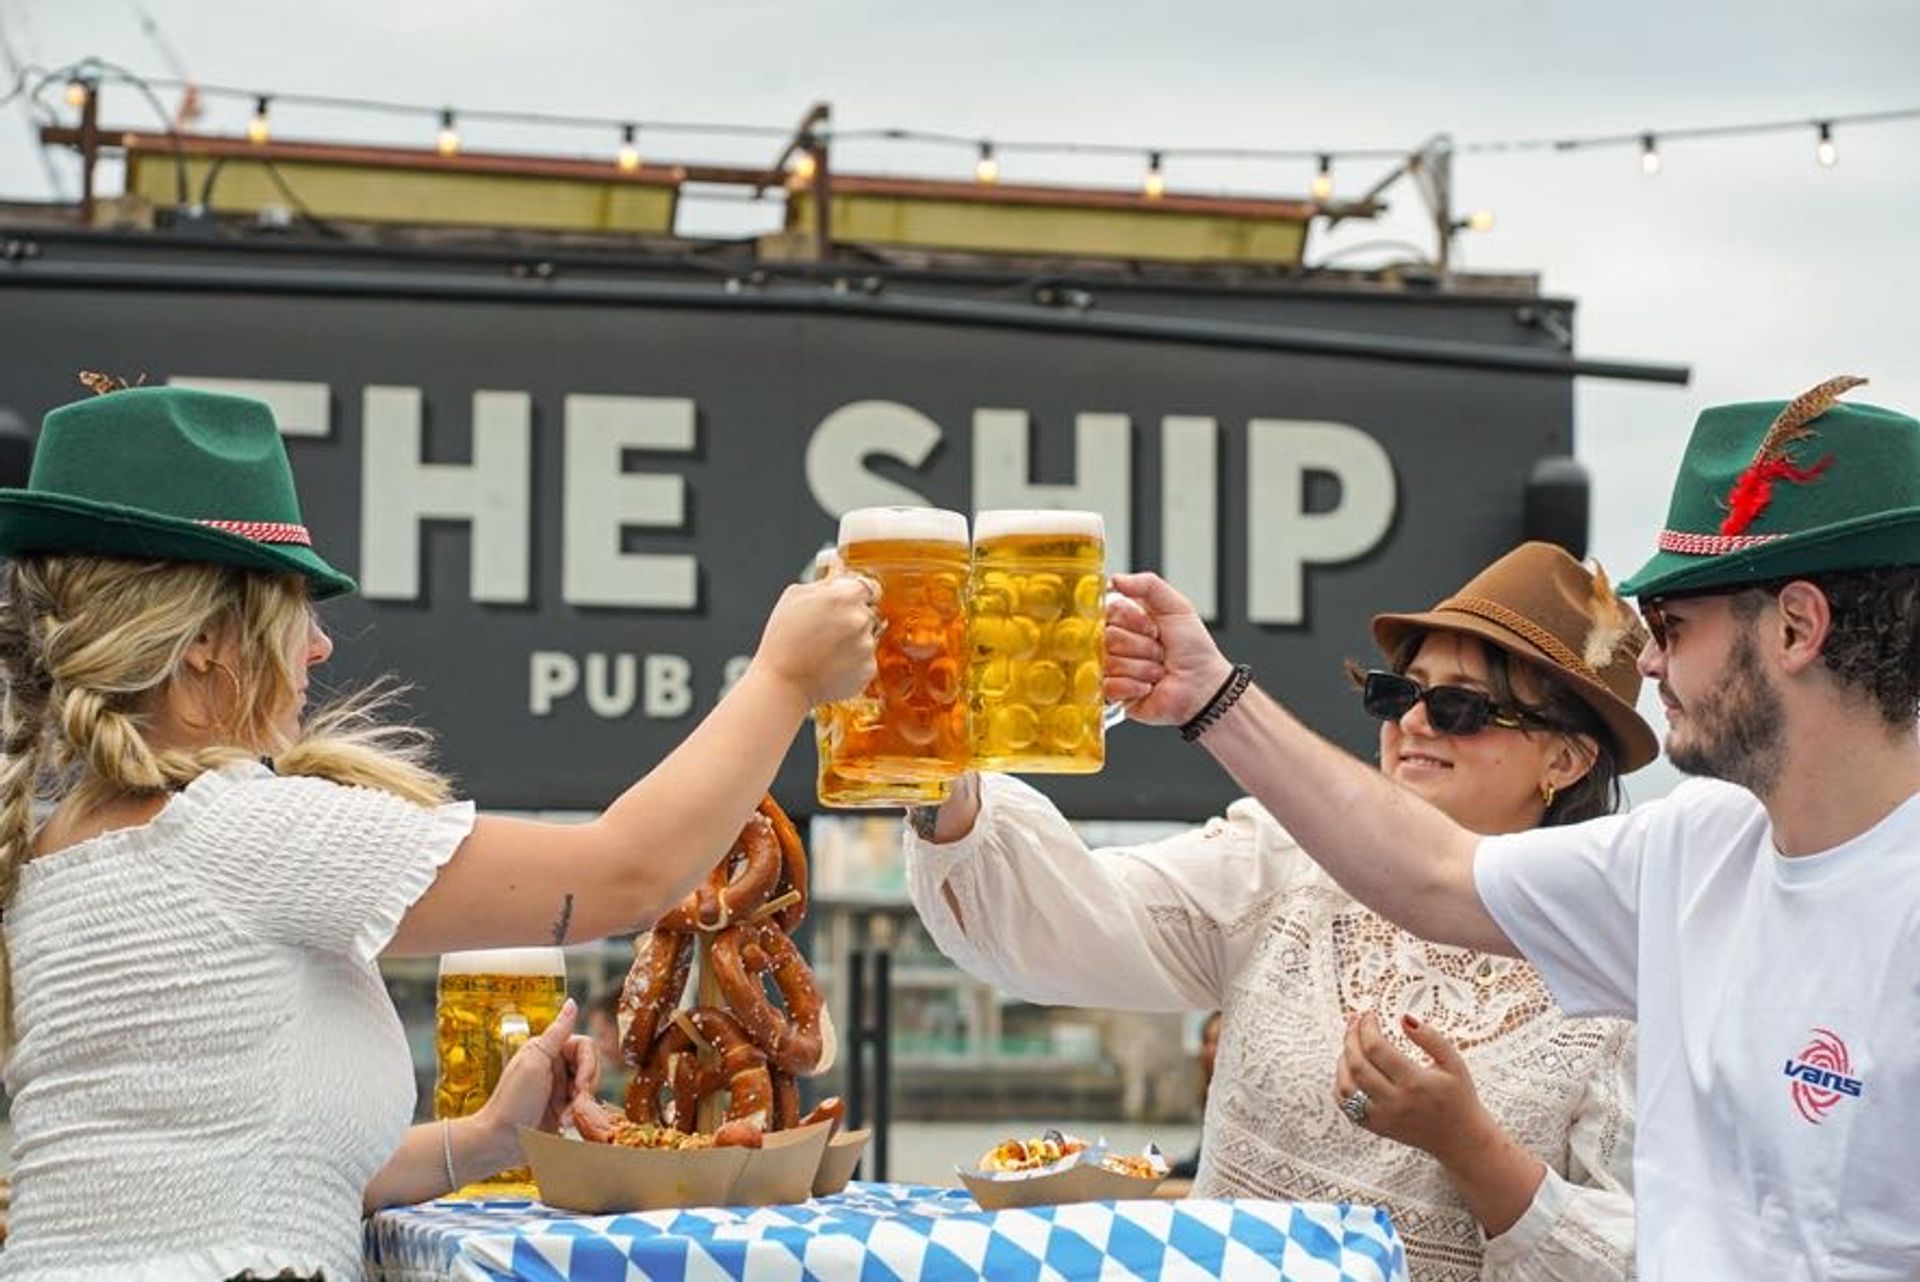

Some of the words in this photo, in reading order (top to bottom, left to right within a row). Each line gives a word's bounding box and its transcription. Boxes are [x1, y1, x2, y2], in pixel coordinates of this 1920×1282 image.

[167, 376, 697, 608] HE
[529, 651, 693, 718] PUB
[1784, 1060, 1862, 1097] vans
